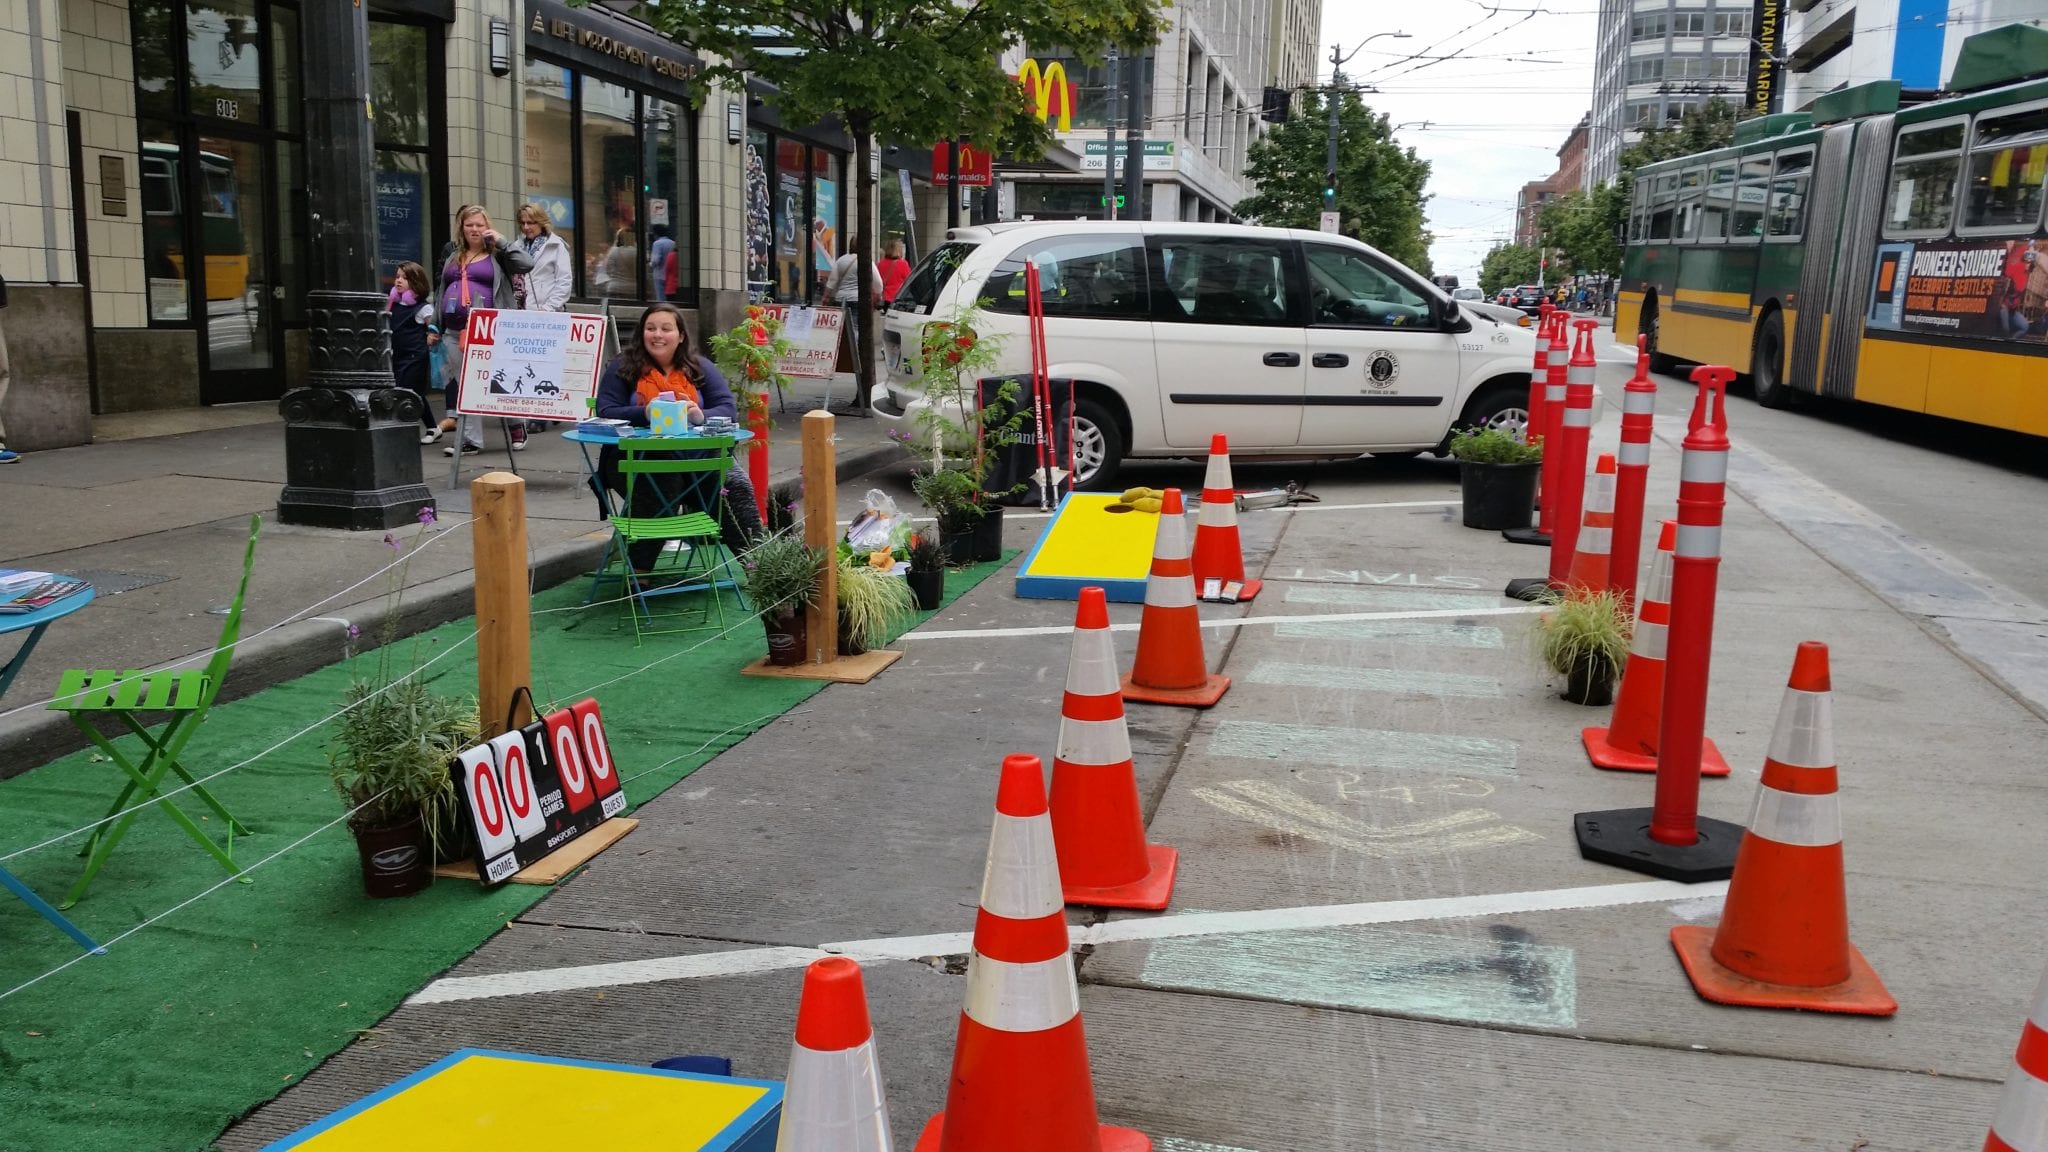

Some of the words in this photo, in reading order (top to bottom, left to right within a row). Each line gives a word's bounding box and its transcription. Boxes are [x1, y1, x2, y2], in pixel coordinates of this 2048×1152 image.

[577, 27, 648, 67] IMPROVEMENT
[217, 100, 237, 118] 305
[935, 172, 986, 182] Mcnald's
[384, 205, 411, 219] TEST
[1912, 250, 1956, 277] PIONEER
[1956, 248, 2007, 277] SQUARE
[1908, 277, 1951, 295] CELEBRATE
[504, 337, 557, 347] ADVENTURE
[513, 347, 547, 355] COURSE
[471, 349, 492, 361] FRO
[807, 349, 834, 360] AREA
[535, 731, 548, 766] 1
[539, 789, 562, 808] PERIOD
[604, 795, 625, 814] GUEST
[543, 799, 565, 818] GAMES
[490, 858, 514, 879] HOME
